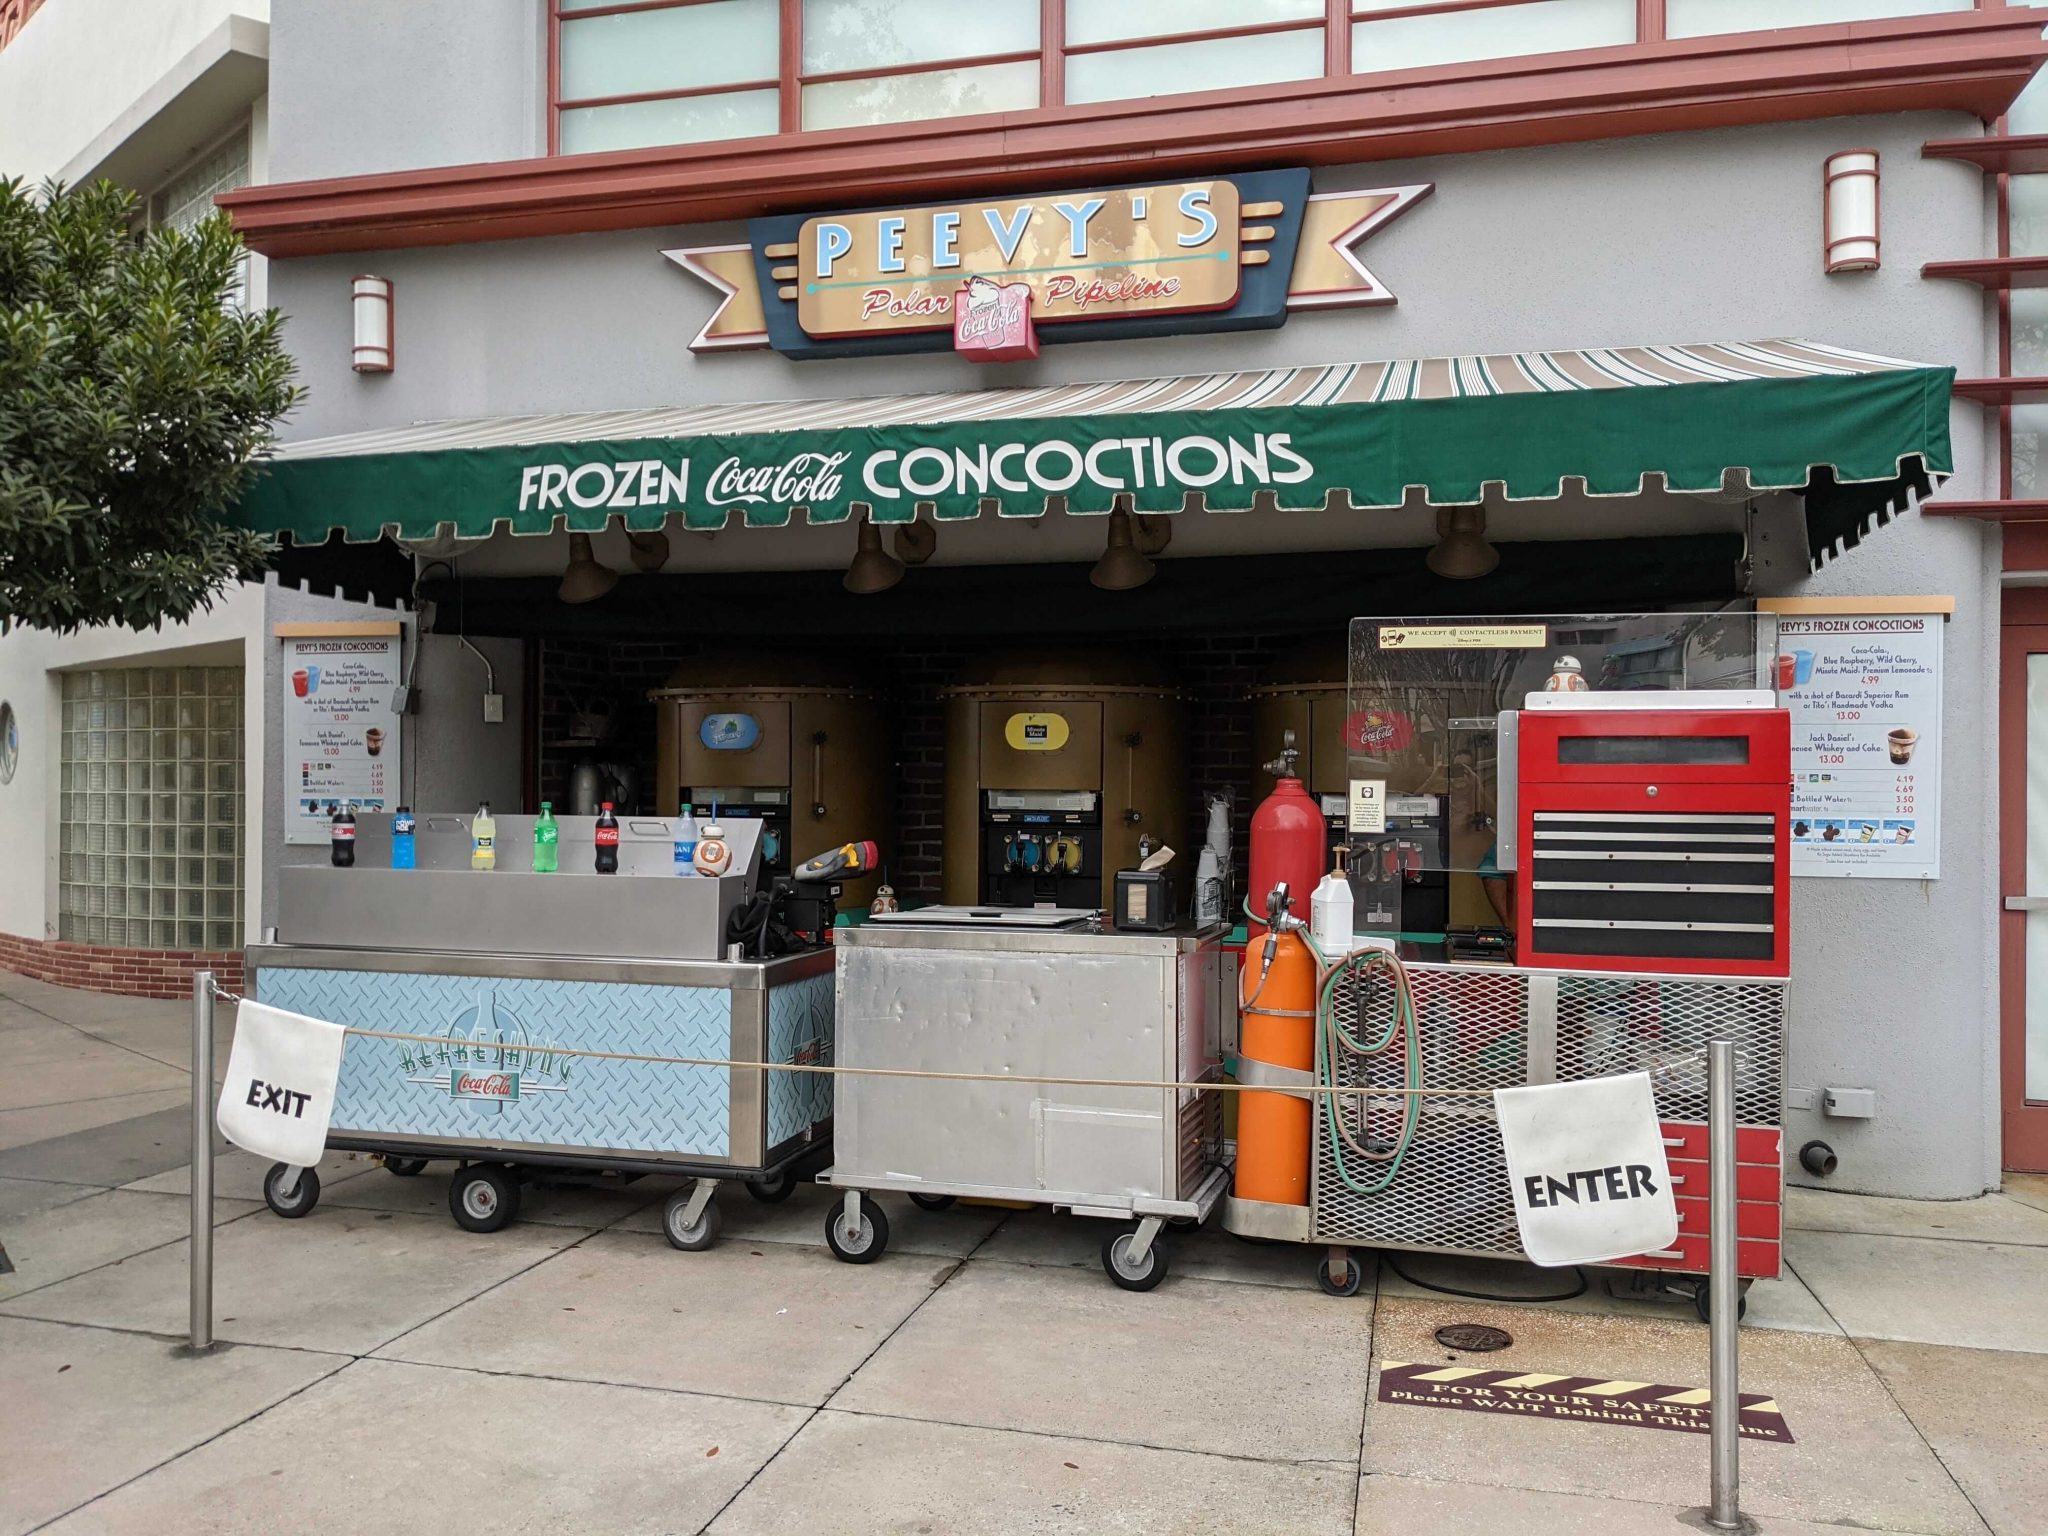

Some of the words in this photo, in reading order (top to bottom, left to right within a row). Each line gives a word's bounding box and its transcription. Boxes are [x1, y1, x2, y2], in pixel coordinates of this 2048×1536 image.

[816, 190, 1219, 279] PEEVY'S
[862, 288, 951, 318] Polar
[1045, 273, 1180, 308] Pipeline
[519, 458, 690, 512] FROZEN
[862, 433, 1314, 498] CONCOCTIONS
[1780, 621, 1810, 632] EEVY'S
[1813, 620, 1850, 632] FROZEN
[1852, 619, 1925, 631] CONCOCTIONS
[319, 642, 342, 652] FROZEN
[343, 642, 389, 651] CONCOCTIONS
[1876, 655, 1893, 664] Wild
[1863, 666, 1890, 674] Premium
[1861, 676, 1880, 684] 4.99
[1788, 691, 1802, 699] with
[1811, 691, 1824, 699] shot
[1826, 691, 1834, 699] of
[1864, 690, 1893, 700] Superior
[1895, 690, 1909, 698] Rum
[1836, 712, 1861, 720] 13.00
[1809, 733, 1825, 742] Jack
[1815, 743, 1844, 753] Whiskey
[1846, 744, 1860, 752] and
[1819, 755, 1844, 763] 13.00
[1896, 775, 1914, 783] 4.19
[1895, 785, 1914, 793] 4.69
[1796, 795, 1823, 803] Bottled
[1825, 795, 1846, 803] Water
[1896, 795, 1914, 803] 3.50
[1895, 805, 1914, 813] 5.50
[399, 1027, 576, 1083] REFRESHING
[457, 1072, 512, 1096] Coca-Cola
[246, 1079, 312, 1119] EXIT
[1524, 1164, 1658, 1208] ENTER
[1432, 1384, 1495, 1397] FOR
[1504, 1390, 1594, 1406] YOUR
[1603, 1399, 1711, 1417] SAFET
[1391, 1391, 1463, 1404] Please
[1471, 1398, 1546, 1412] WAIT
[1553, 1406, 1644, 1422] Behind
[1651, 1414, 1710, 1429] This
[1738, 1422, 1778, 1436] ine
